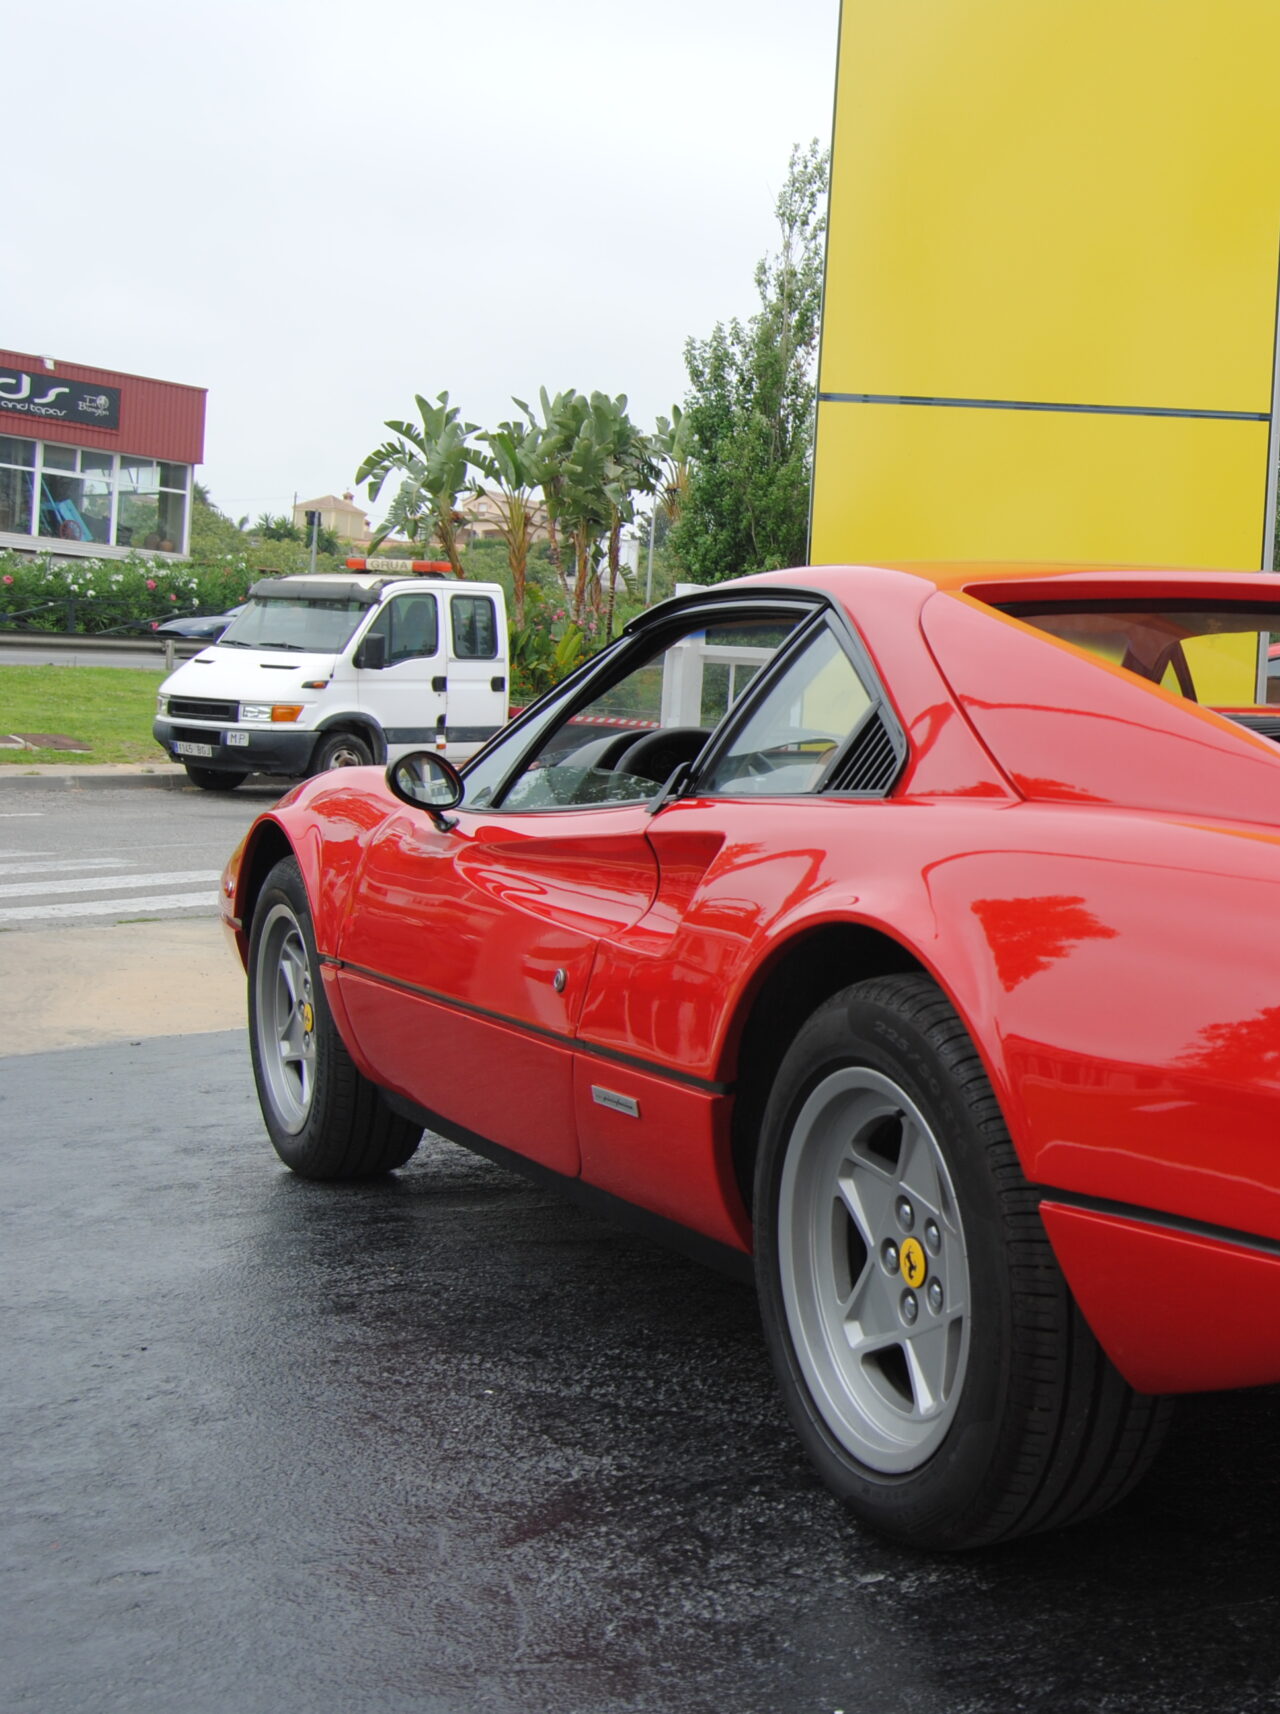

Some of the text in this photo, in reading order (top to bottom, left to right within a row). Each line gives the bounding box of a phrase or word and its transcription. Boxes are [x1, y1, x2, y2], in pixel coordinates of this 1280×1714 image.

[1, 400, 68, 416] and tapas
[370, 560, 409, 571] GRUA
